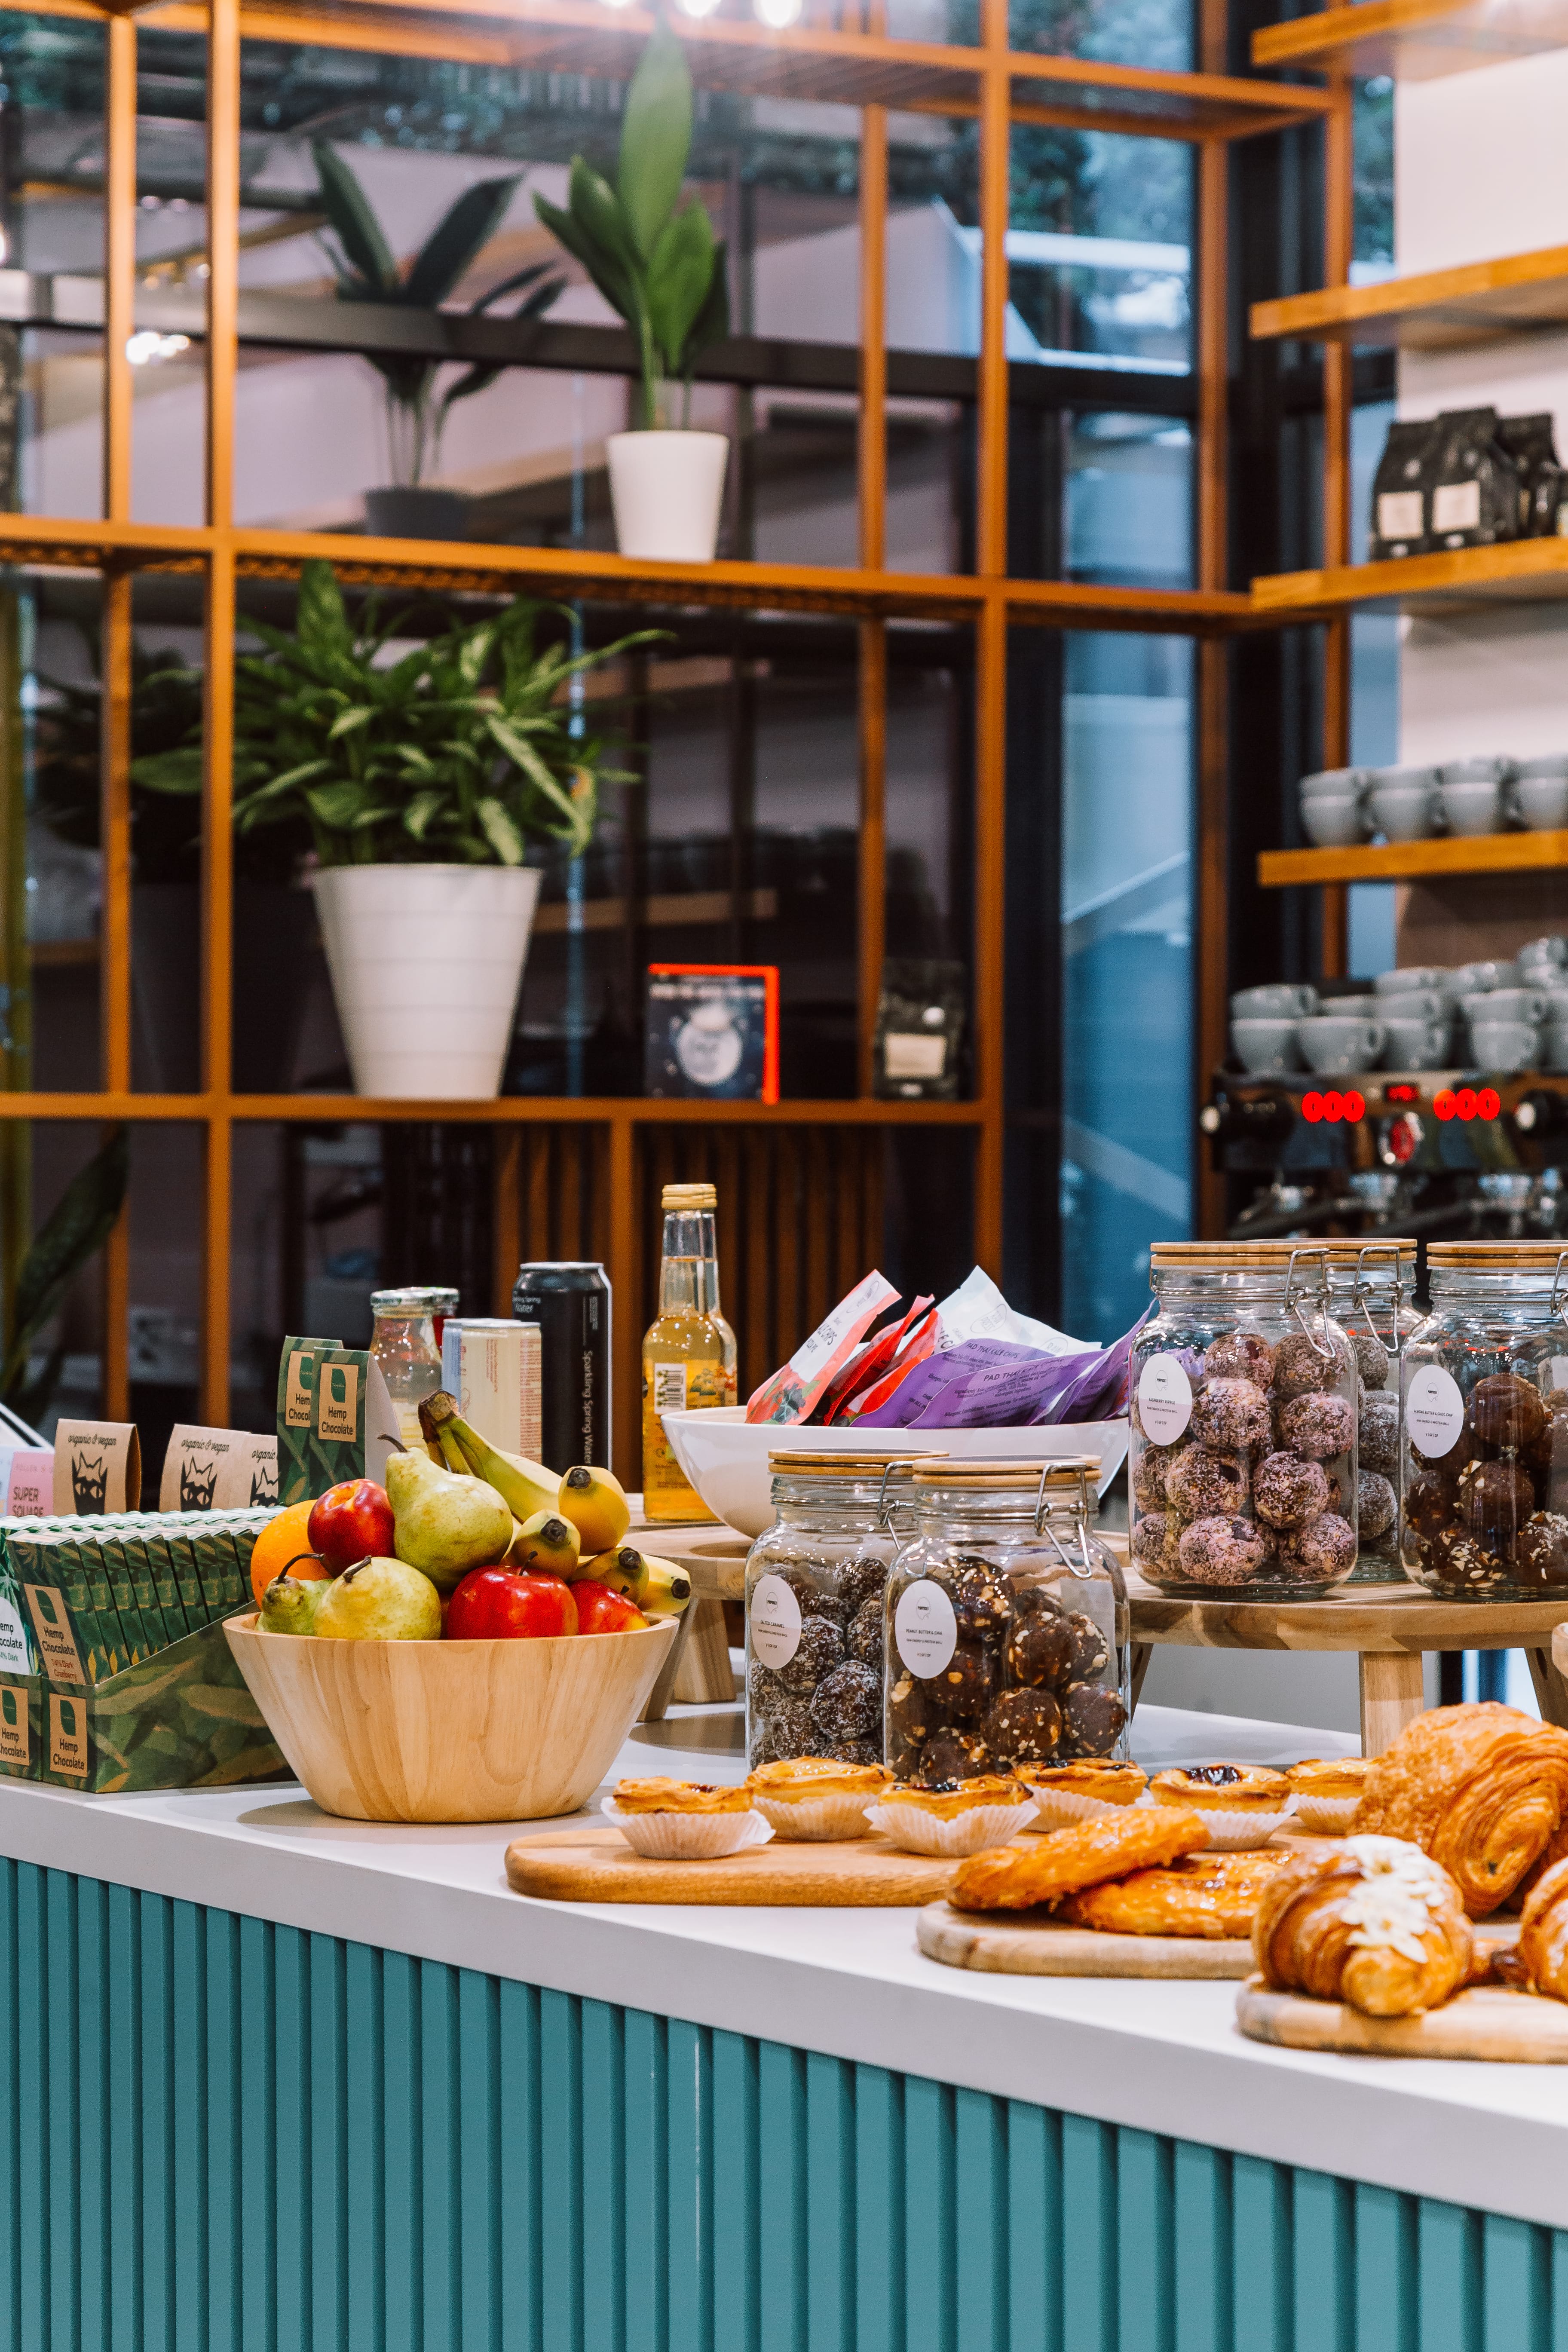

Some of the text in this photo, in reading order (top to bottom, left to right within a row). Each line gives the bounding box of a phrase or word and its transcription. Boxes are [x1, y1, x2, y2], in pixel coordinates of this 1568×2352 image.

[977, 1345, 992, 1354] THAI
[582, 1351, 593, 1398] Sparkling
[295, 1393, 310, 1405] Hem
[289, 1408, 310, 1421] Chocol
[328, 1406, 347, 1421] Hemp
[582, 1400, 594, 1433] Spring
[322, 1421, 353, 1435] Chocolate
[68, 1433, 91, 1447] organic
[98, 1436, 117, 1449] vegan
[181, 1439, 205, 1452] organic
[211, 1442, 230, 1455] vegan
[251, 1449, 276, 1463] organic
[13, 1486, 39, 1502] SUPER
[0, 1622, 14, 1635] emp
[43, 1626, 64, 1642] Hemp
[0, 1637, 22, 1649] ocolate
[42, 1640, 75, 1656] Chocolate
[8, 1653, 18, 1661] Dark
[62, 1660, 74, 1669] Dark
[54, 1669, 77, 1681] Cranberry
[1, 1727, 19, 1744] Hemp
[59, 1738, 78, 1755] Hemp
[53, 1753, 84, 1770] Chocolate
